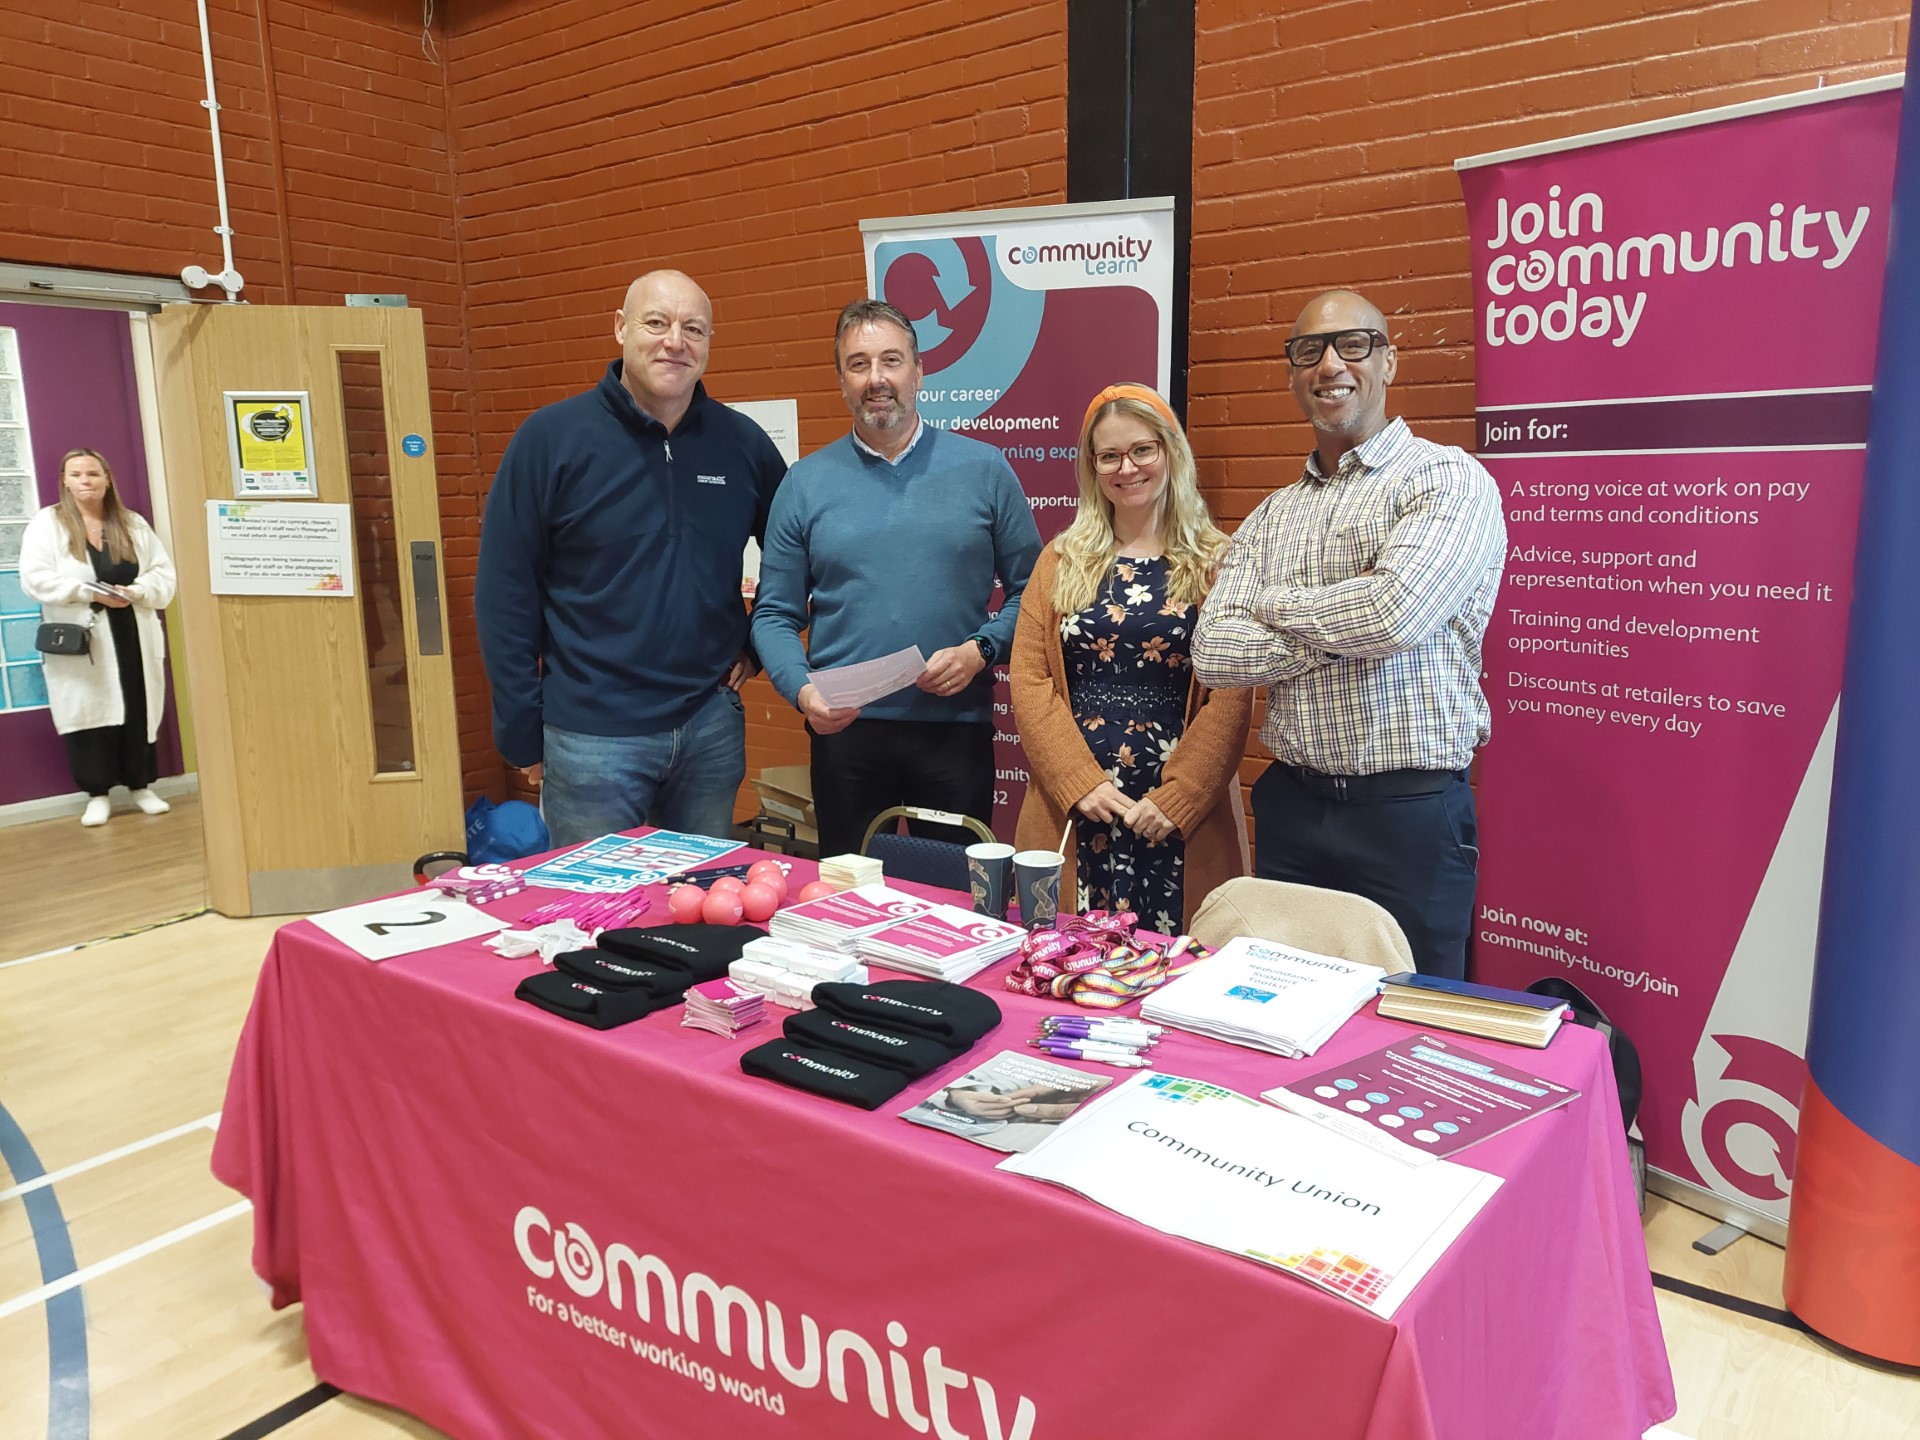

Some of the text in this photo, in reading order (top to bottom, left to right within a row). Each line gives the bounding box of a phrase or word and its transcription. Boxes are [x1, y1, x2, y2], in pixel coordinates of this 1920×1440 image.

[1487, 185, 1603, 249] Join
[1008, 235, 1152, 264] community
[1487, 203, 1870, 295] community
[1486, 288, 1646, 347] today
[950, 389, 1000, 401] career
[951, 415, 1059, 433] development
[1484, 419, 1568, 446] Join for:
[1511, 478, 1810, 501] A strong voice at work on pay
[1510, 506, 1758, 524] and terms and conditions
[1509, 546, 1696, 568] Advice, support and
[1509, 572, 1832, 602] representation when you need it
[1508, 609, 1760, 643] Training and development
[1508, 635, 1629, 658] opportunities
[1508, 672, 1786, 718] Discounts at retailers to save
[1508, 698, 1702, 738] you money every day
[364, 911, 446, 936] 2
[1480, 904, 1588, 946] Join now at:
[1249, 944, 1356, 973] community
[1249, 964, 1317, 982] Redundancy
[1481, 929, 1678, 998] community-tu.org/join
[1249, 977, 1288, 990] Toolkit
[1252, 972, 1298, 985] Support
[831, 1020, 908, 1048] community
[782, 1052, 859, 1080] community
[1127, 1121, 1284, 1187] Community
[1291, 1180, 1381, 1216] Union
[513, 1206, 1036, 1440] community
[527, 1286, 785, 1416] For a better working world
